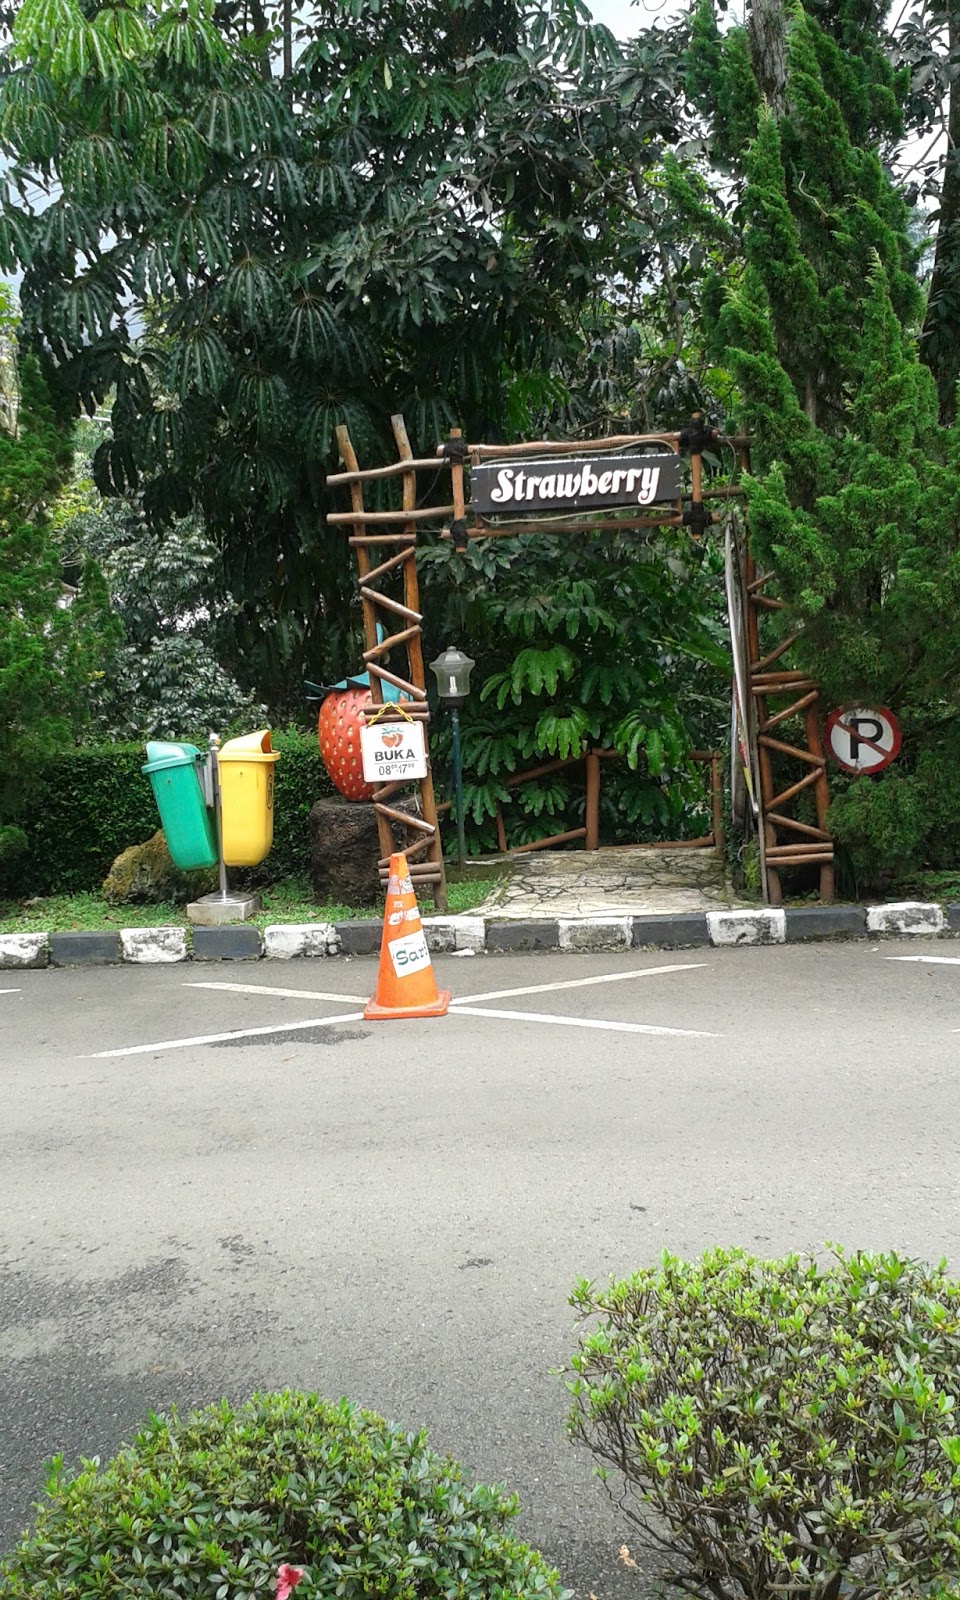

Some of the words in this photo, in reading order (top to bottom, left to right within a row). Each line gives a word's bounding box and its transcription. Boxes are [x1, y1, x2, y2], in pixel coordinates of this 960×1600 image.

[491, 464, 660, 505] Strawberry
[374, 749, 416, 762] BUKA
[850, 718, 884, 760] P
